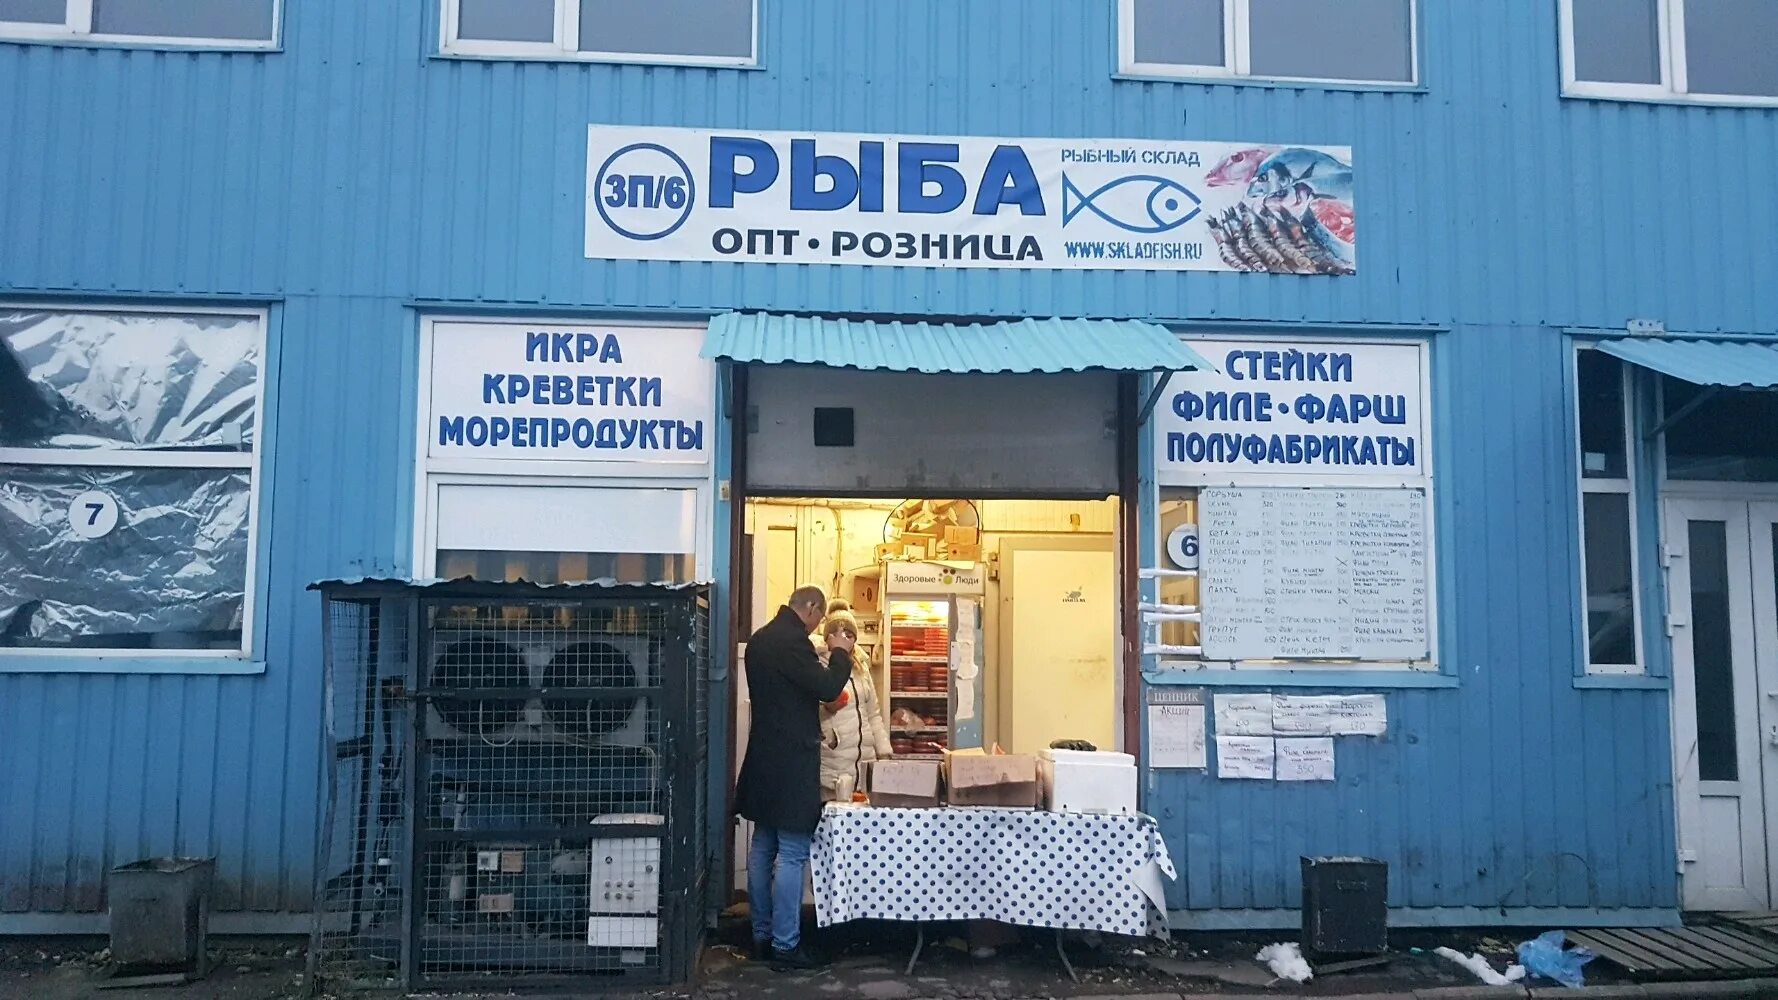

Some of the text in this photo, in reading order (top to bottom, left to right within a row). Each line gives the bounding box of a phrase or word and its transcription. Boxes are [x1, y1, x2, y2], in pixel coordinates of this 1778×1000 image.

[1061, 147, 1201, 168] РЫБНЫЙ СКЛАД
[709, 135, 1047, 217] РЫБА
[712, 228, 1044, 262] ОПТ РОЗНИЦА
[1064, 240, 1203, 261] WWW.SKLADFISH.RU
[526, 332, 623, 364] ИКРА
[1225, 348, 1352, 382] СТЕЙКИ
[483, 374, 662, 407] КРЕВЕТКИ
[1172, 391, 1406, 425] ФИЛЕ ФАРШ
[439, 416, 703, 451] МОРЕПРОДУКТЫ
[1167, 432, 1415, 466] ПОЛУФАБРИКАТЫ
[85, 503, 104, 525] 7
[1181, 535, 1199, 557] 6
[894, 573, 979, 585] Здоровые Люди
